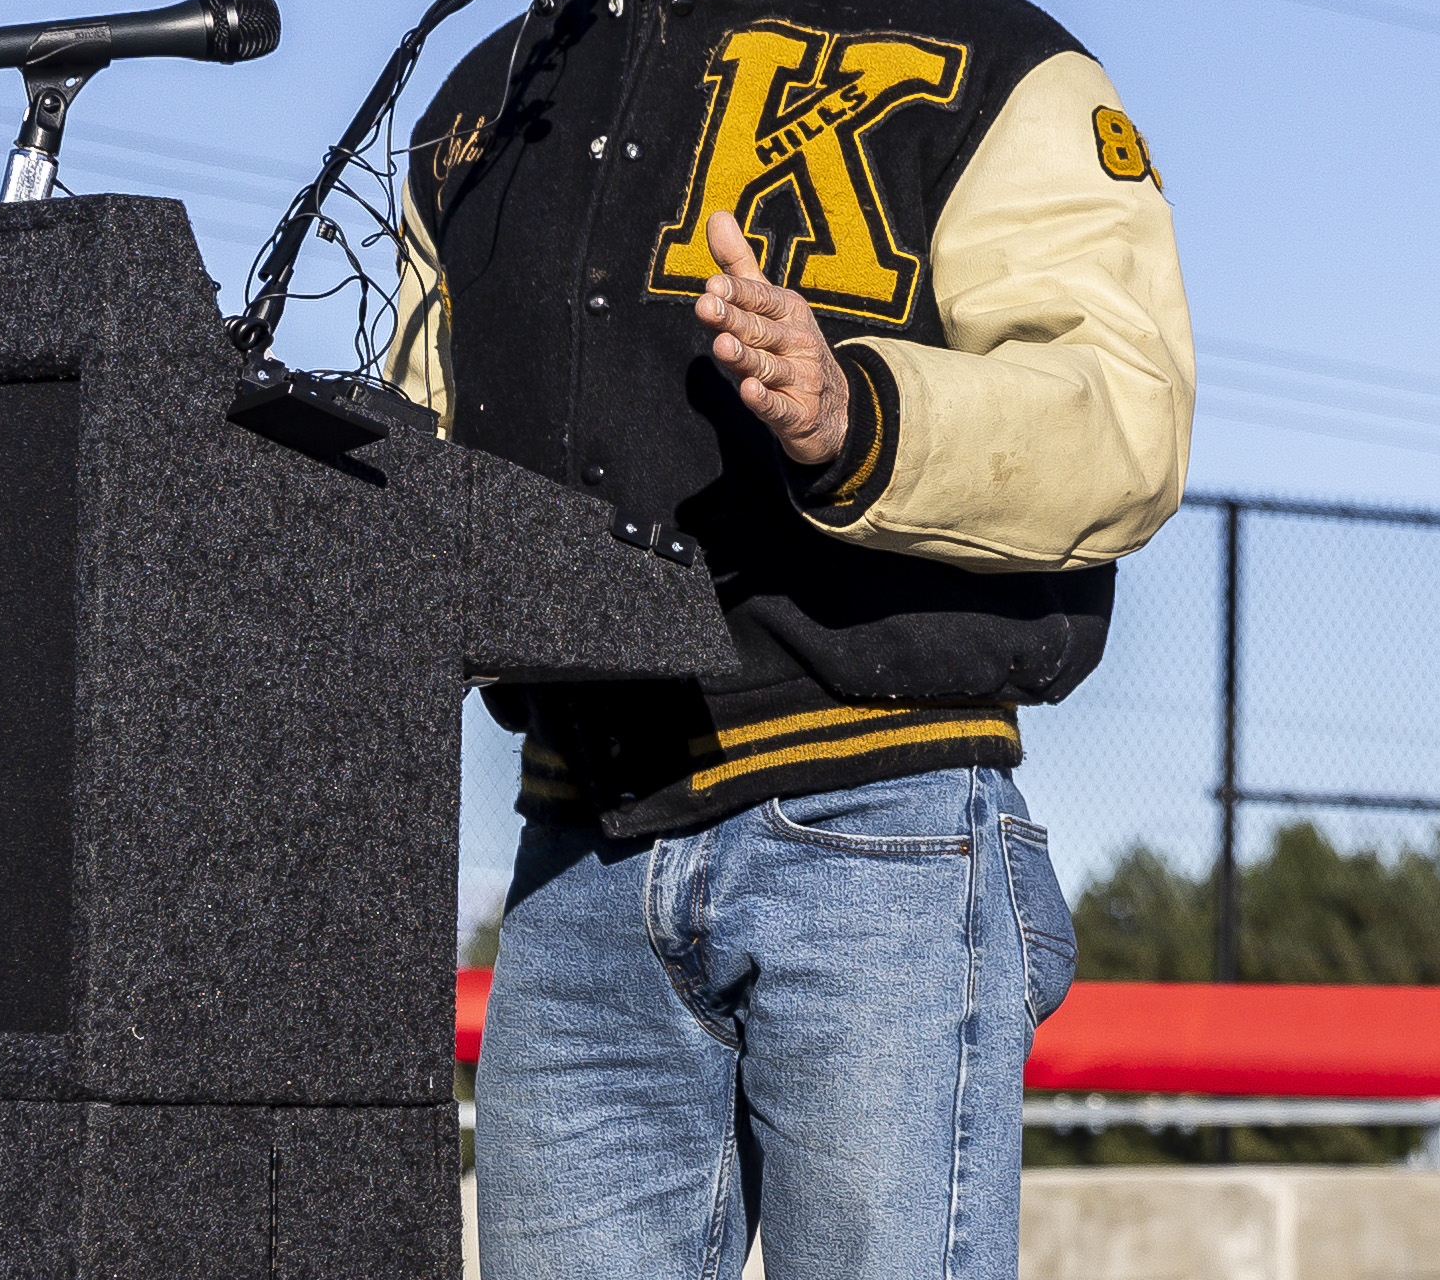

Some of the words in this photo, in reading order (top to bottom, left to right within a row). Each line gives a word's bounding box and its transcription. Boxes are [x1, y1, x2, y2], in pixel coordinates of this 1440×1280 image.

[754, 83, 869, 168] HILLS
[1091, 104, 1163, 194] 8
[647, 18, 968, 325] K
